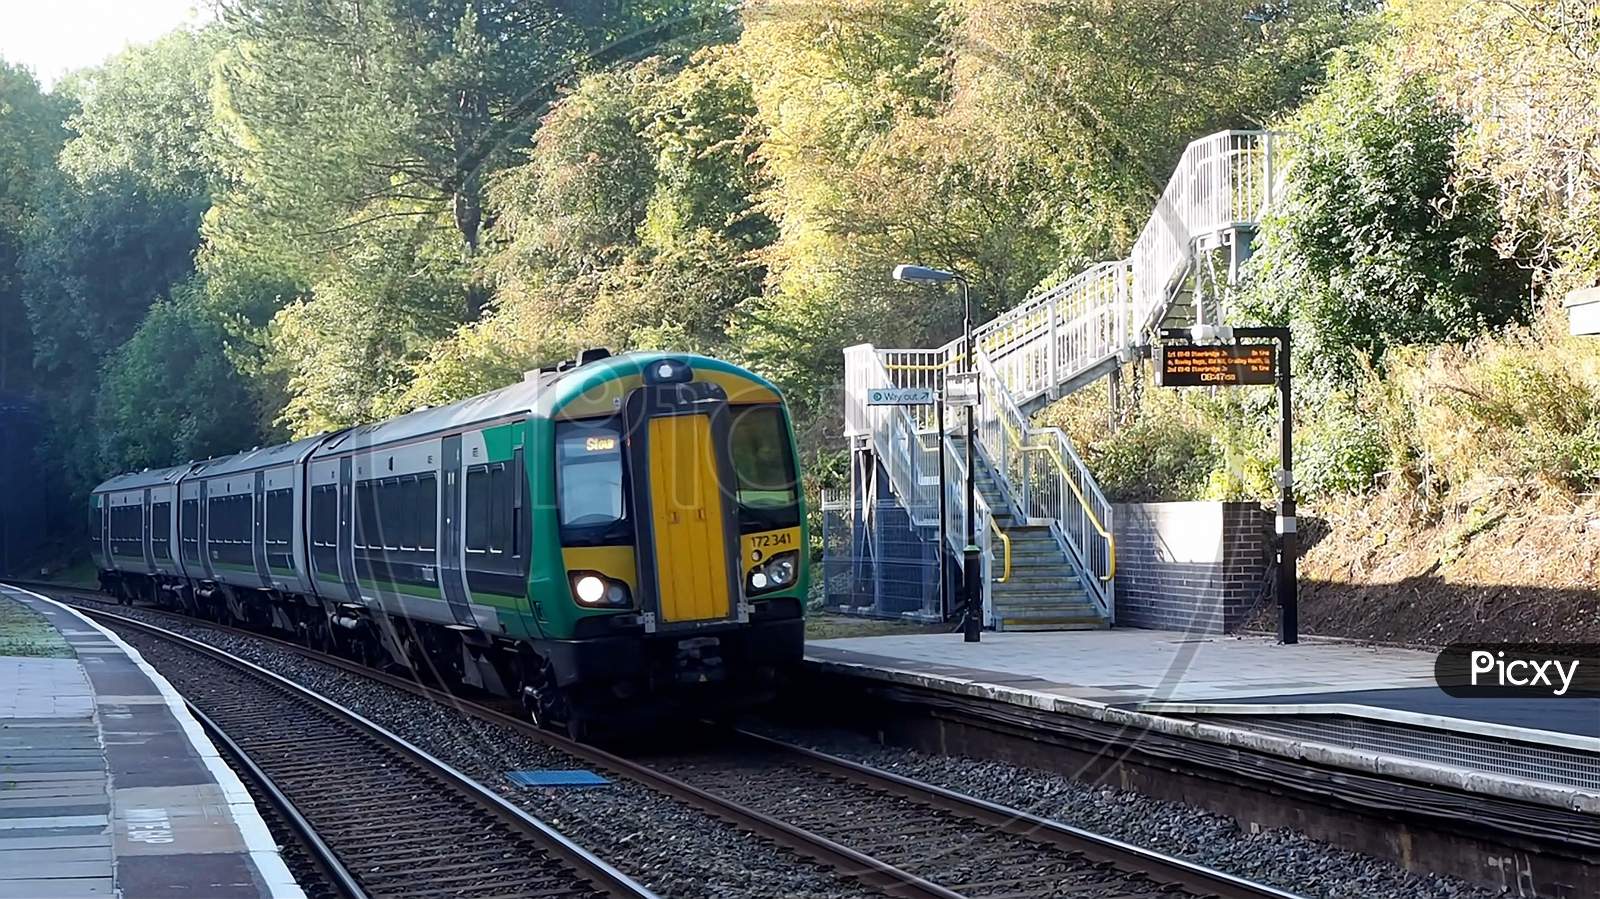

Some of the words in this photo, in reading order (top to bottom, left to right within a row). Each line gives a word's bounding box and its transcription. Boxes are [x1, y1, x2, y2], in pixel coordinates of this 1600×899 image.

[884, 392, 902, 402] Way
[751, 536, 770, 547] 172
[771, 533, 792, 545] 341
